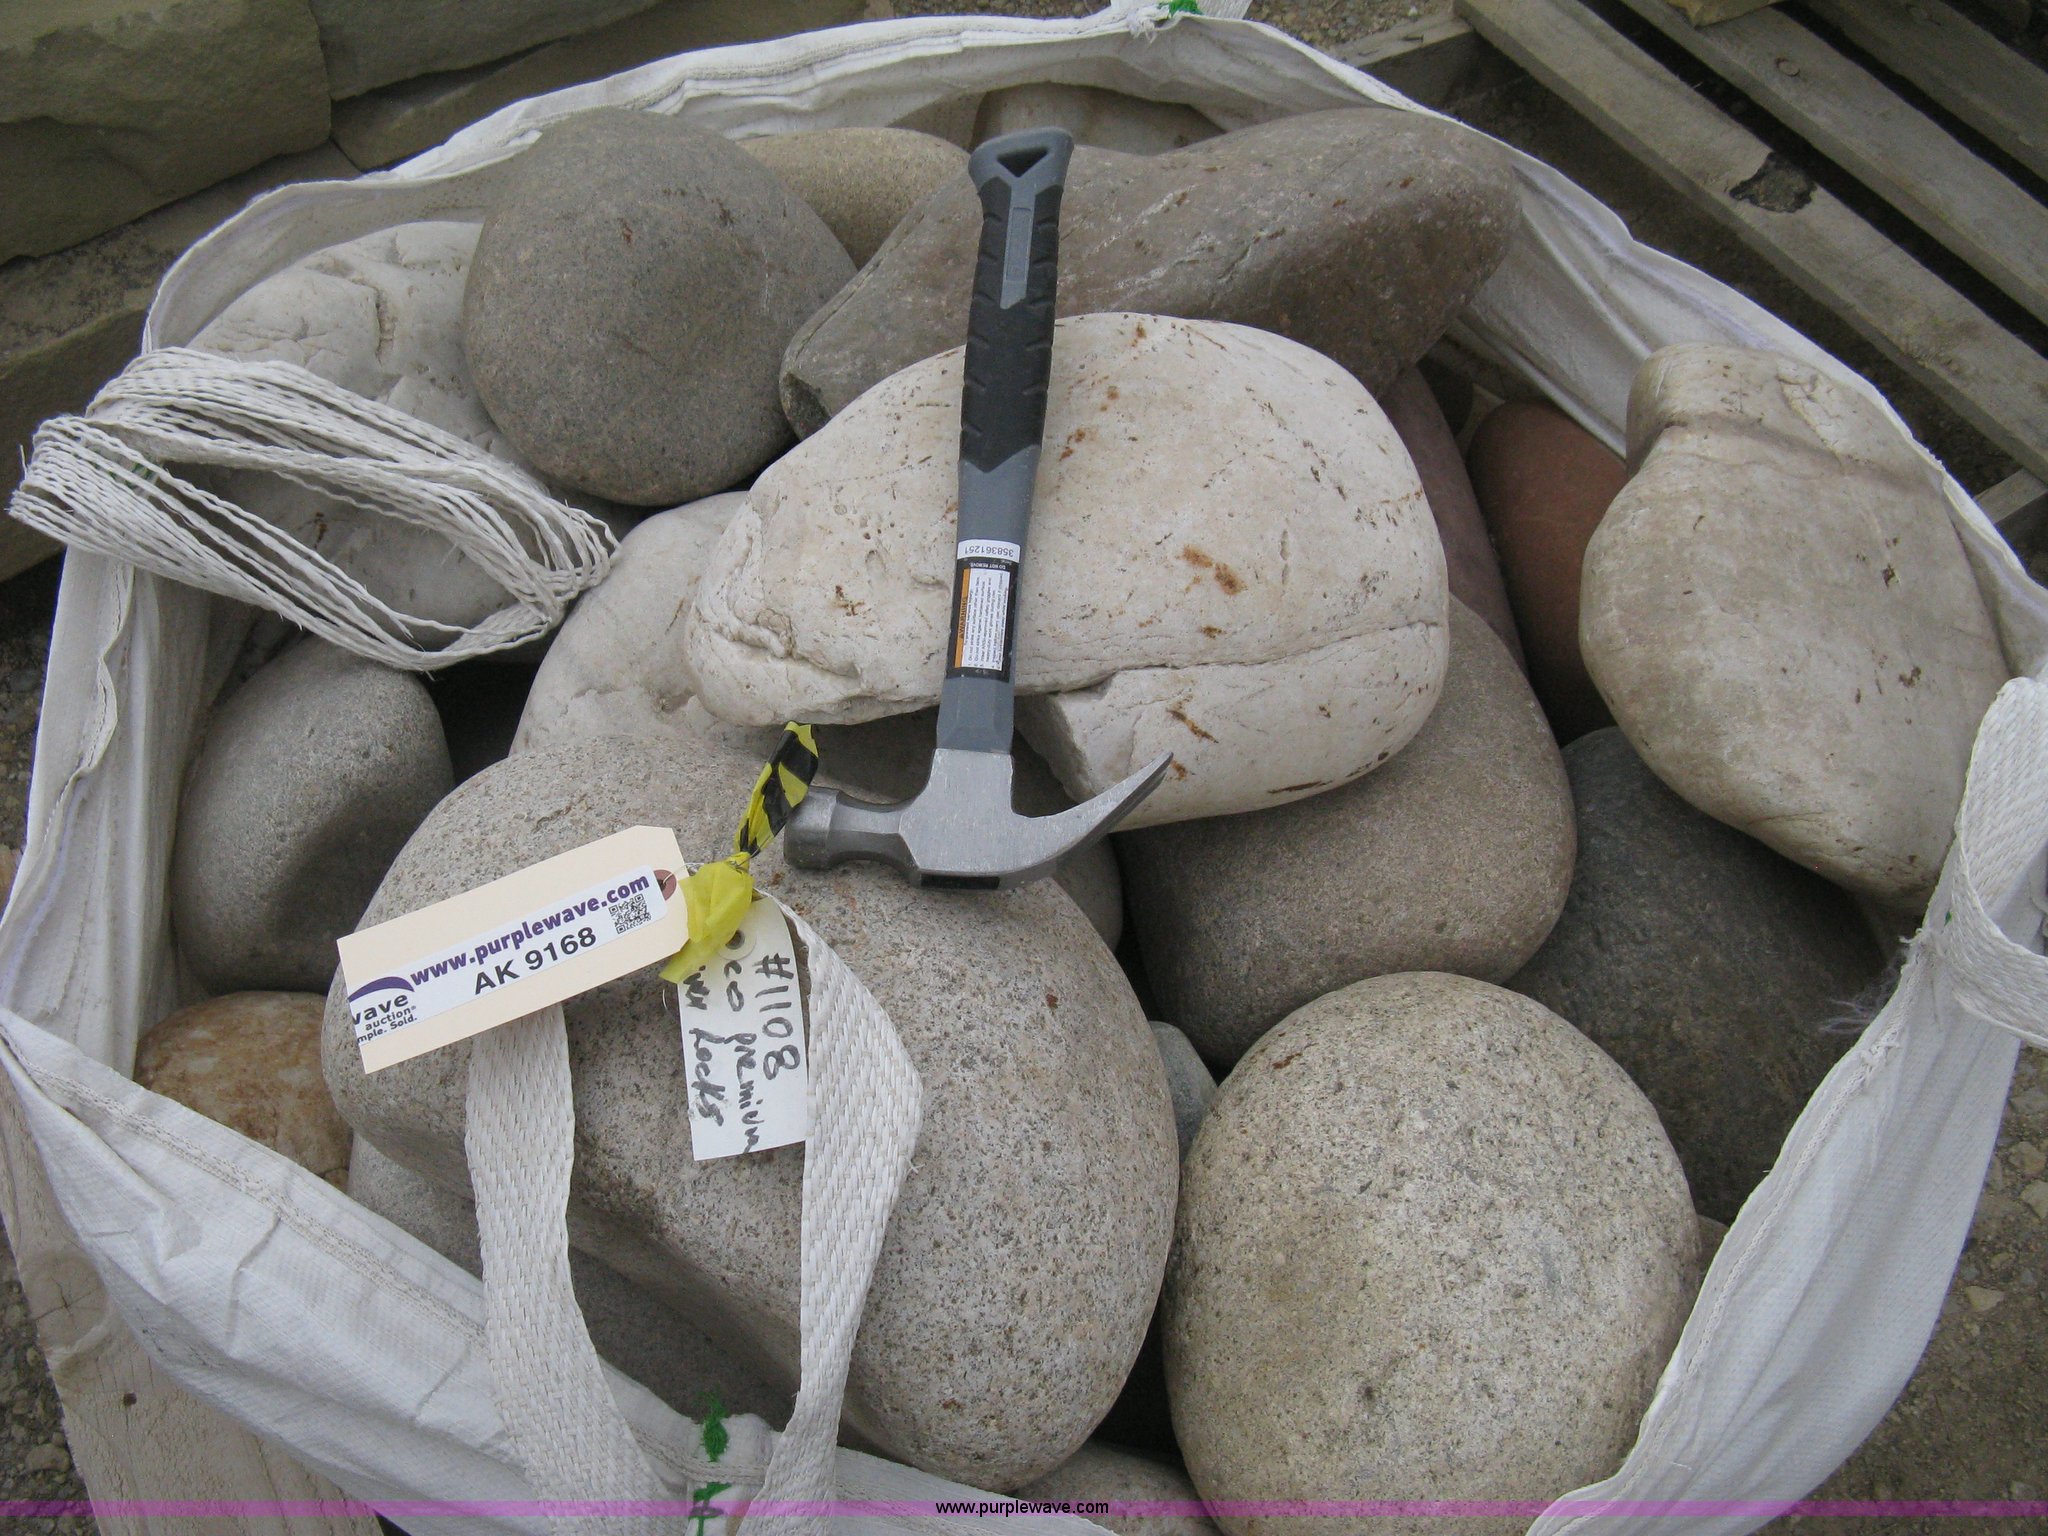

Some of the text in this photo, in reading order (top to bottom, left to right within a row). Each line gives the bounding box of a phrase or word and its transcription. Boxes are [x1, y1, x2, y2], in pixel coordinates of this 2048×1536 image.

[965, 544, 1014, 558] 358361251
[409, 875, 650, 987] www.purplewave.com
[475, 926, 597, 995] AK 9168
[752, 953, 800, 1080] #1108
